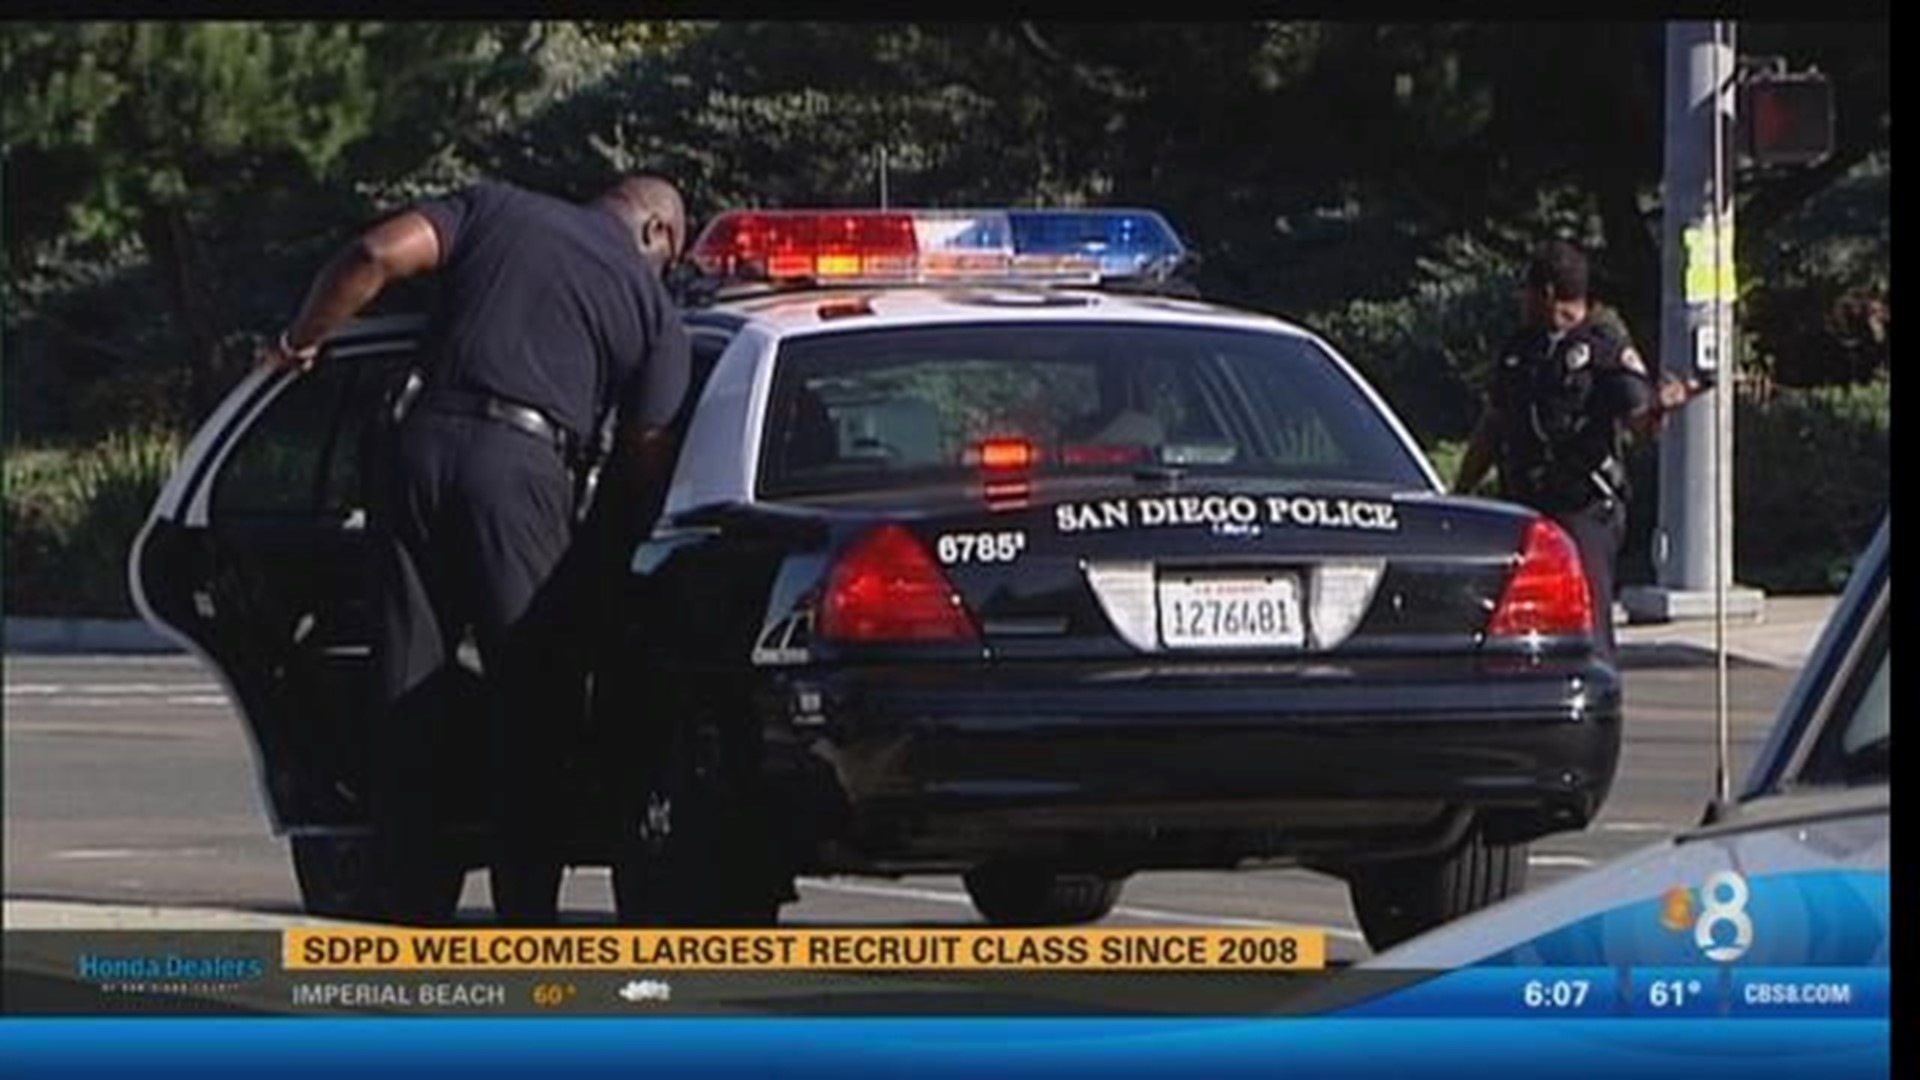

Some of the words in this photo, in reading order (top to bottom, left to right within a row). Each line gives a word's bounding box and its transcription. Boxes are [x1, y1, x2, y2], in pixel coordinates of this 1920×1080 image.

[1056, 503, 1130, 531] SAN
[1140, 496, 1257, 524] DIEGO
[1270, 497, 1398, 530] POLICE
